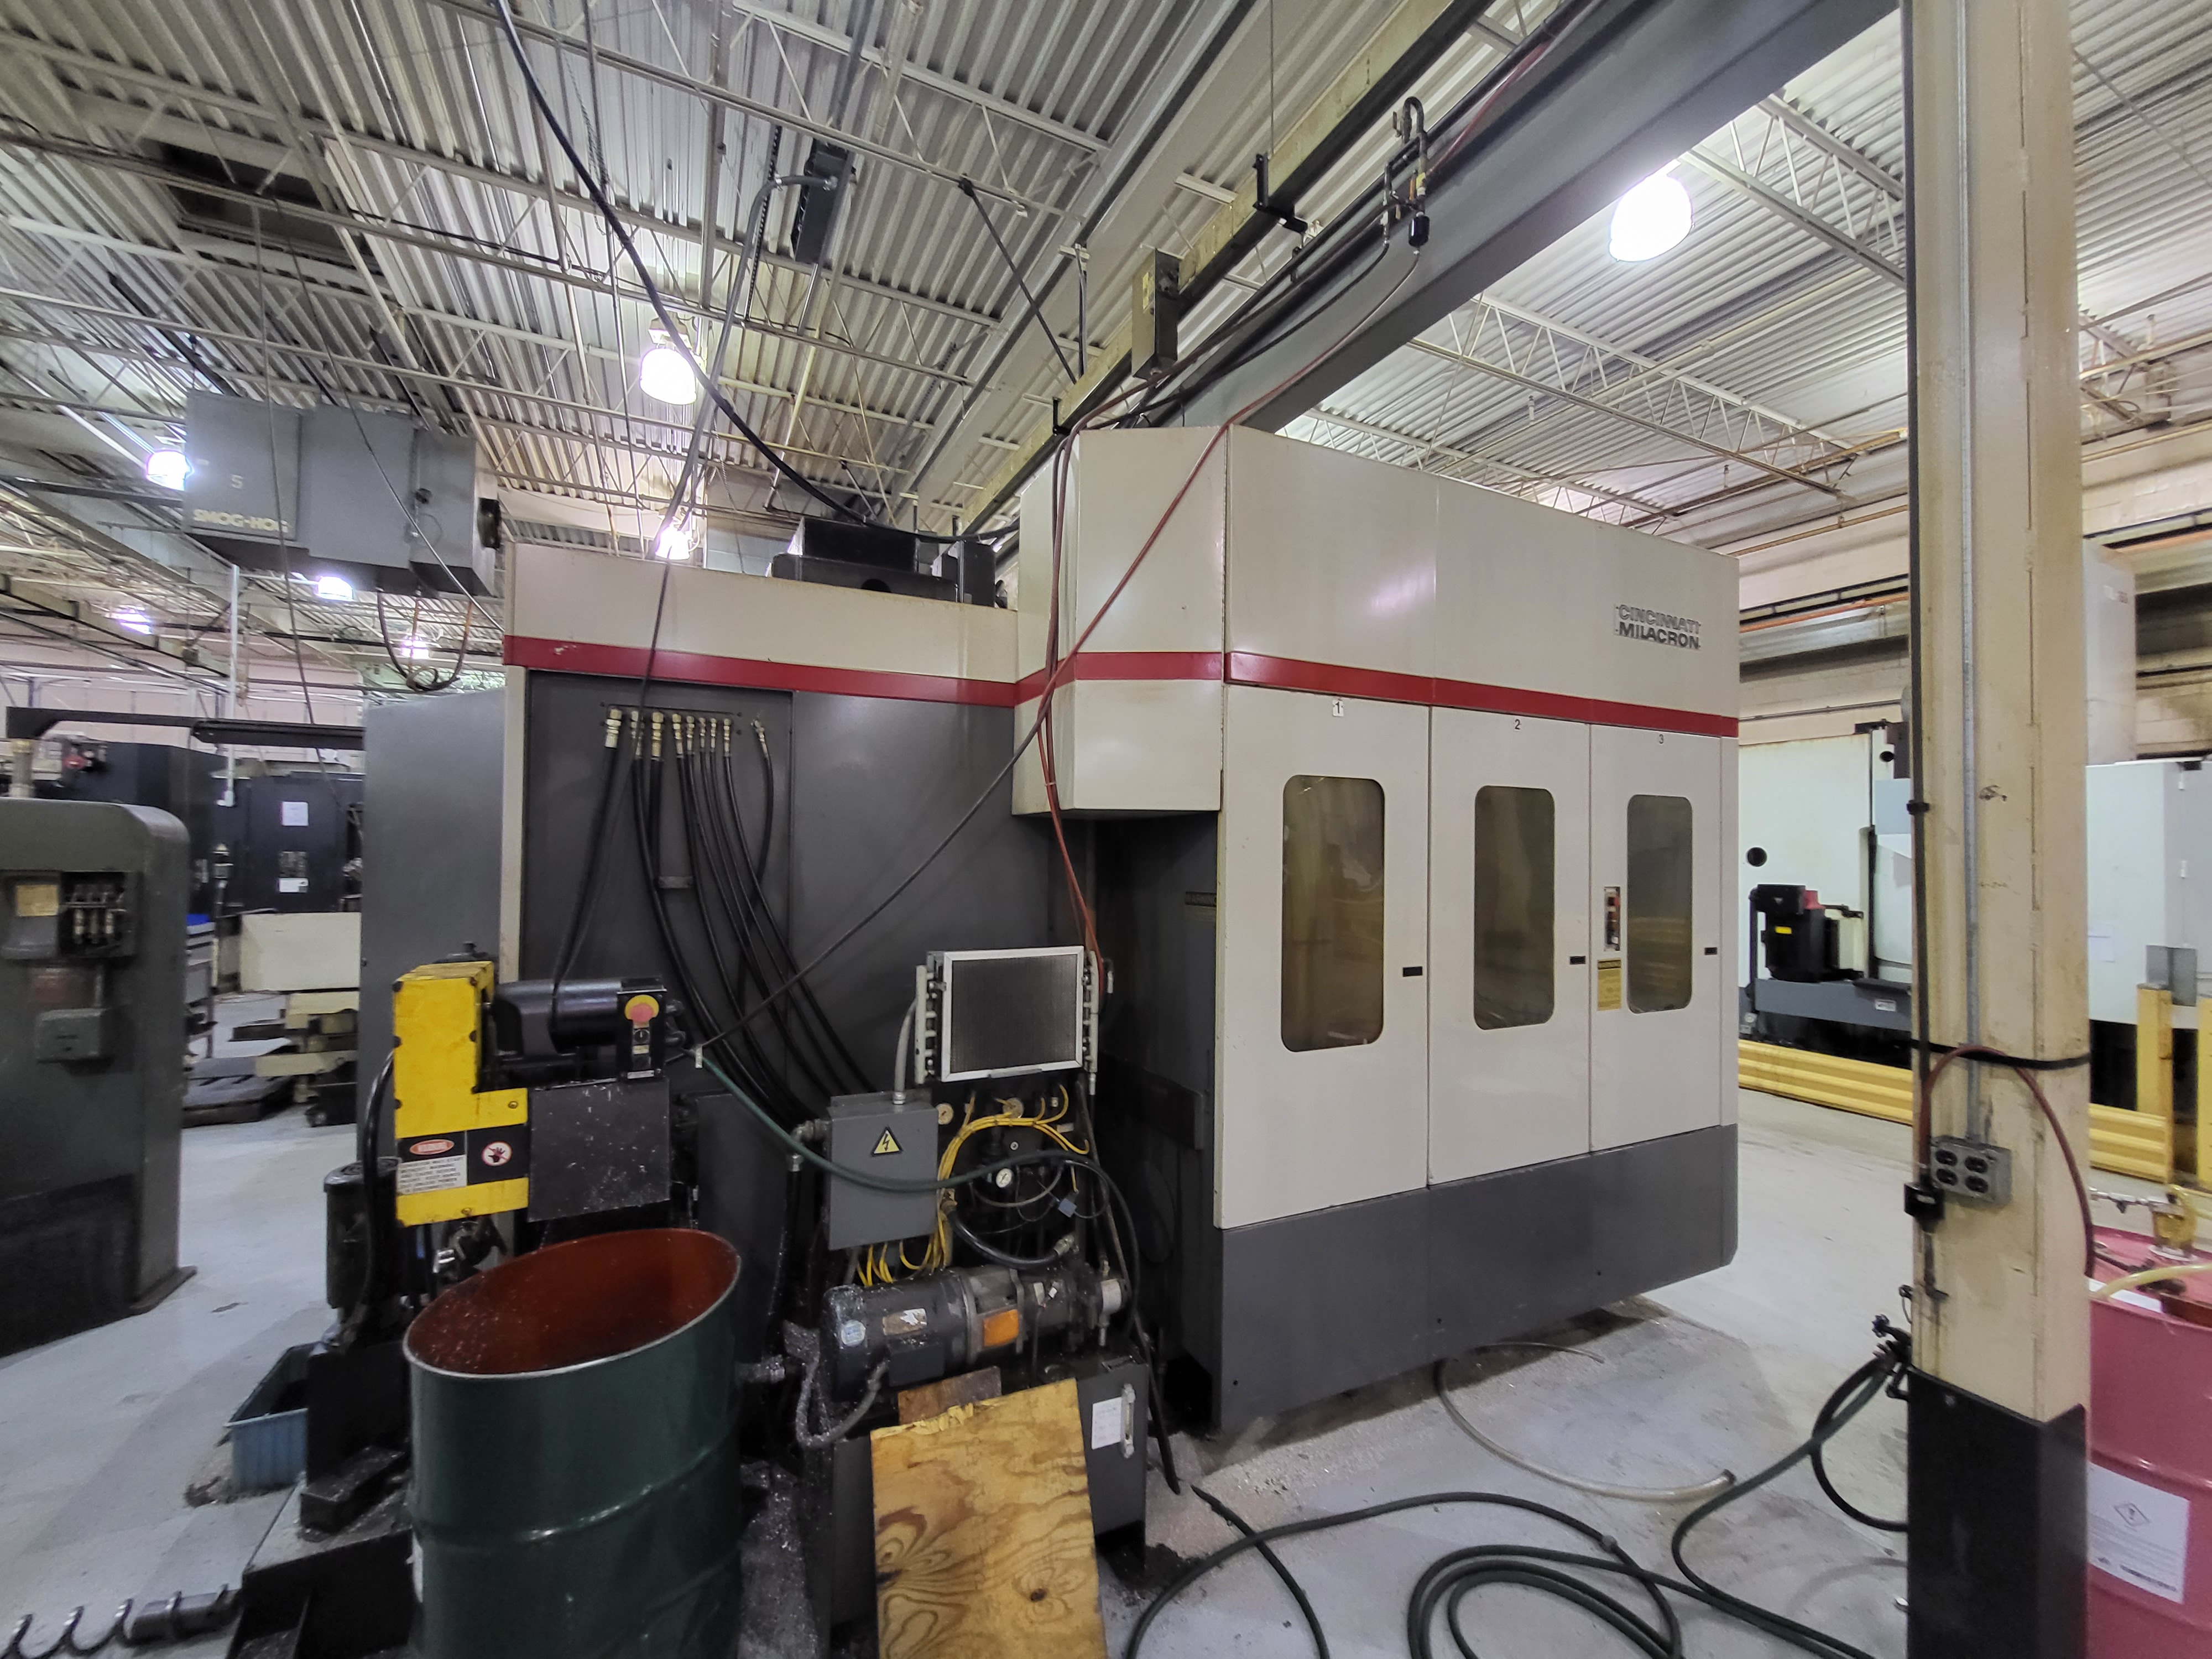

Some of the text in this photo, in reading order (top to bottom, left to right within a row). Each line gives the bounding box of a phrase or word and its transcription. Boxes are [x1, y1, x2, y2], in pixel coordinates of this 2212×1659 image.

[1619, 604, 1699, 634] CINCINNATI
[1619, 621, 1699, 649] MILACRON
[1335, 701, 1340, 714] 1
[1515, 718, 1521, 730] 2
[1658, 734, 1664, 744] 3
